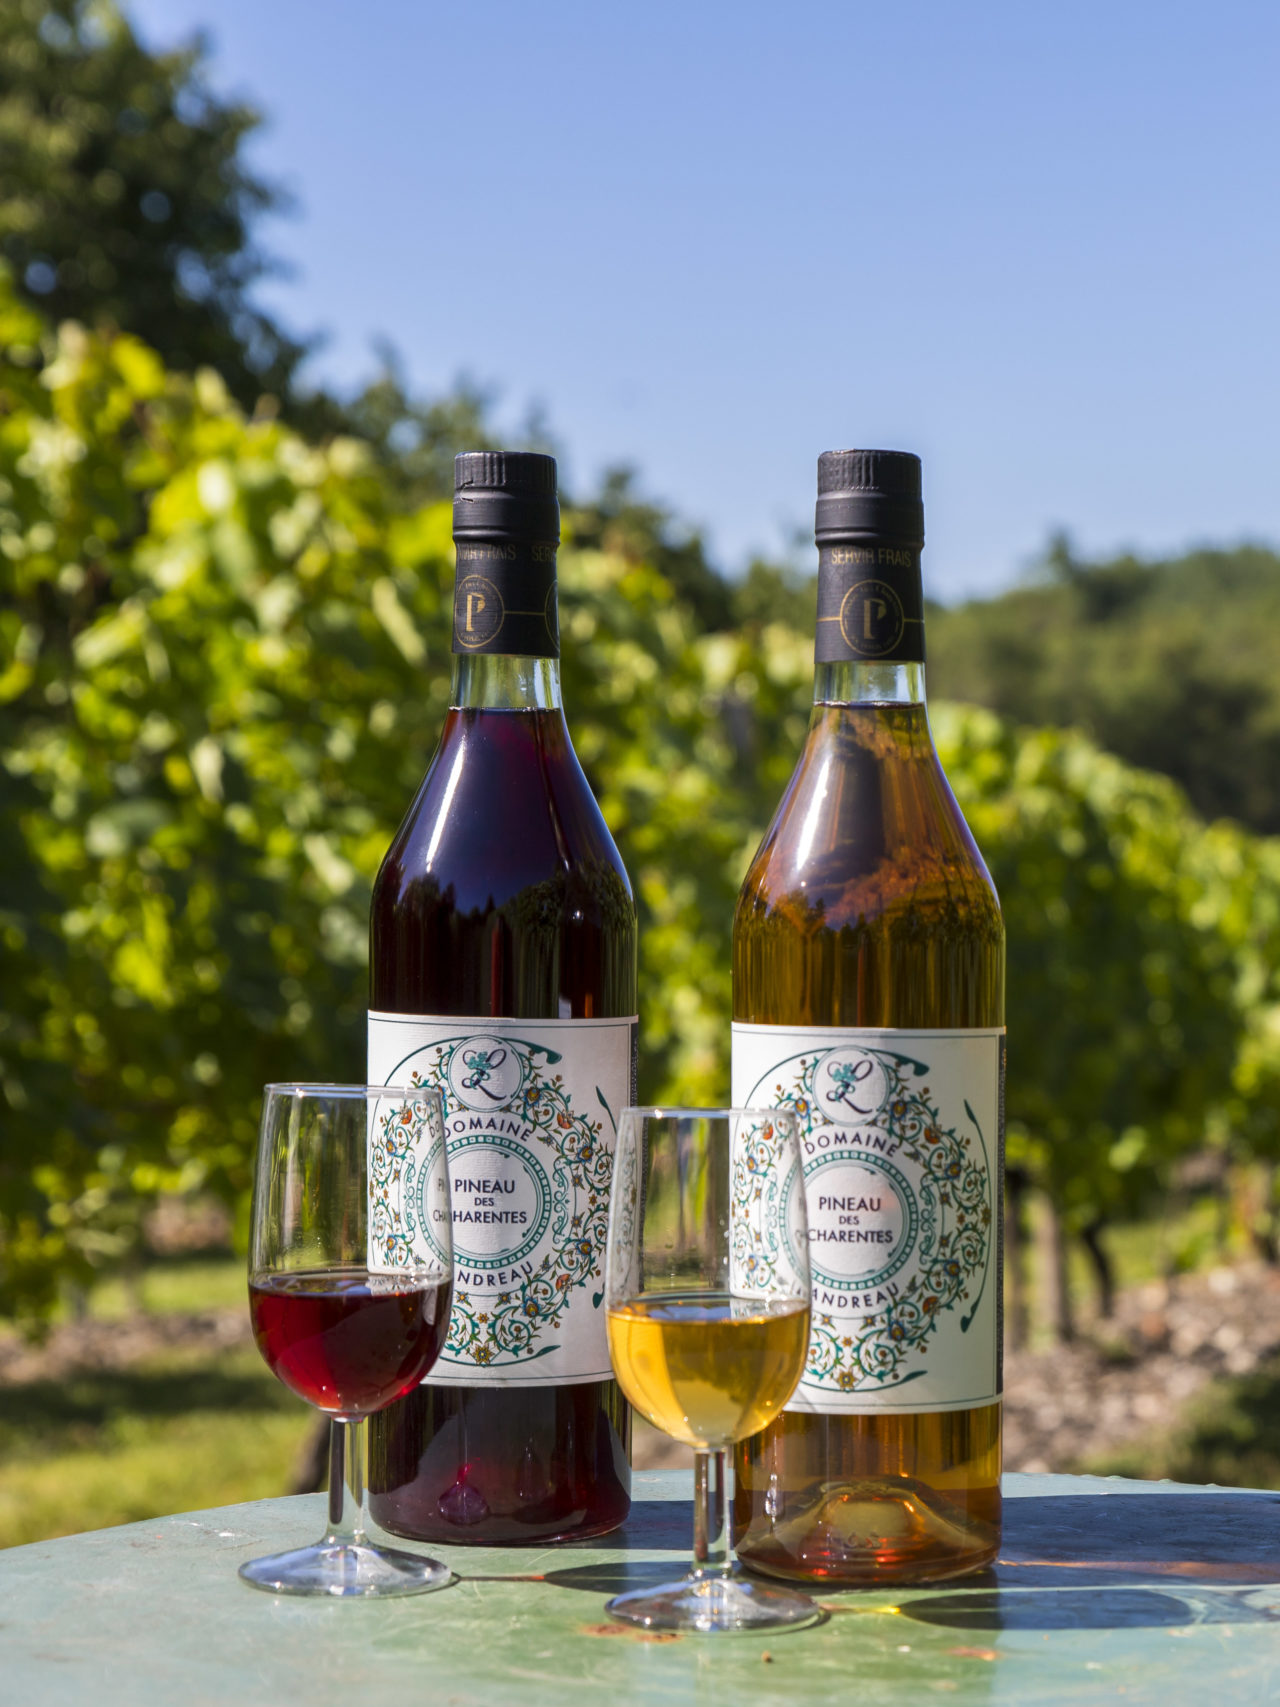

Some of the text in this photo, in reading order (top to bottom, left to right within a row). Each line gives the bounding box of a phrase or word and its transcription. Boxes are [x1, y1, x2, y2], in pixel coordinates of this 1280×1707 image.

[831, 547, 912, 568] SERVIR FRAIS
[804, 1132, 899, 1158] DOMAINE
[454, 1179, 516, 1194] PINEAU
[474, 1197, 494, 1207] DES
[818, 1196, 881, 1212] PINEAU
[838, 1215, 860, 1226] DES
[807, 1229, 894, 1244] CHARENTES
